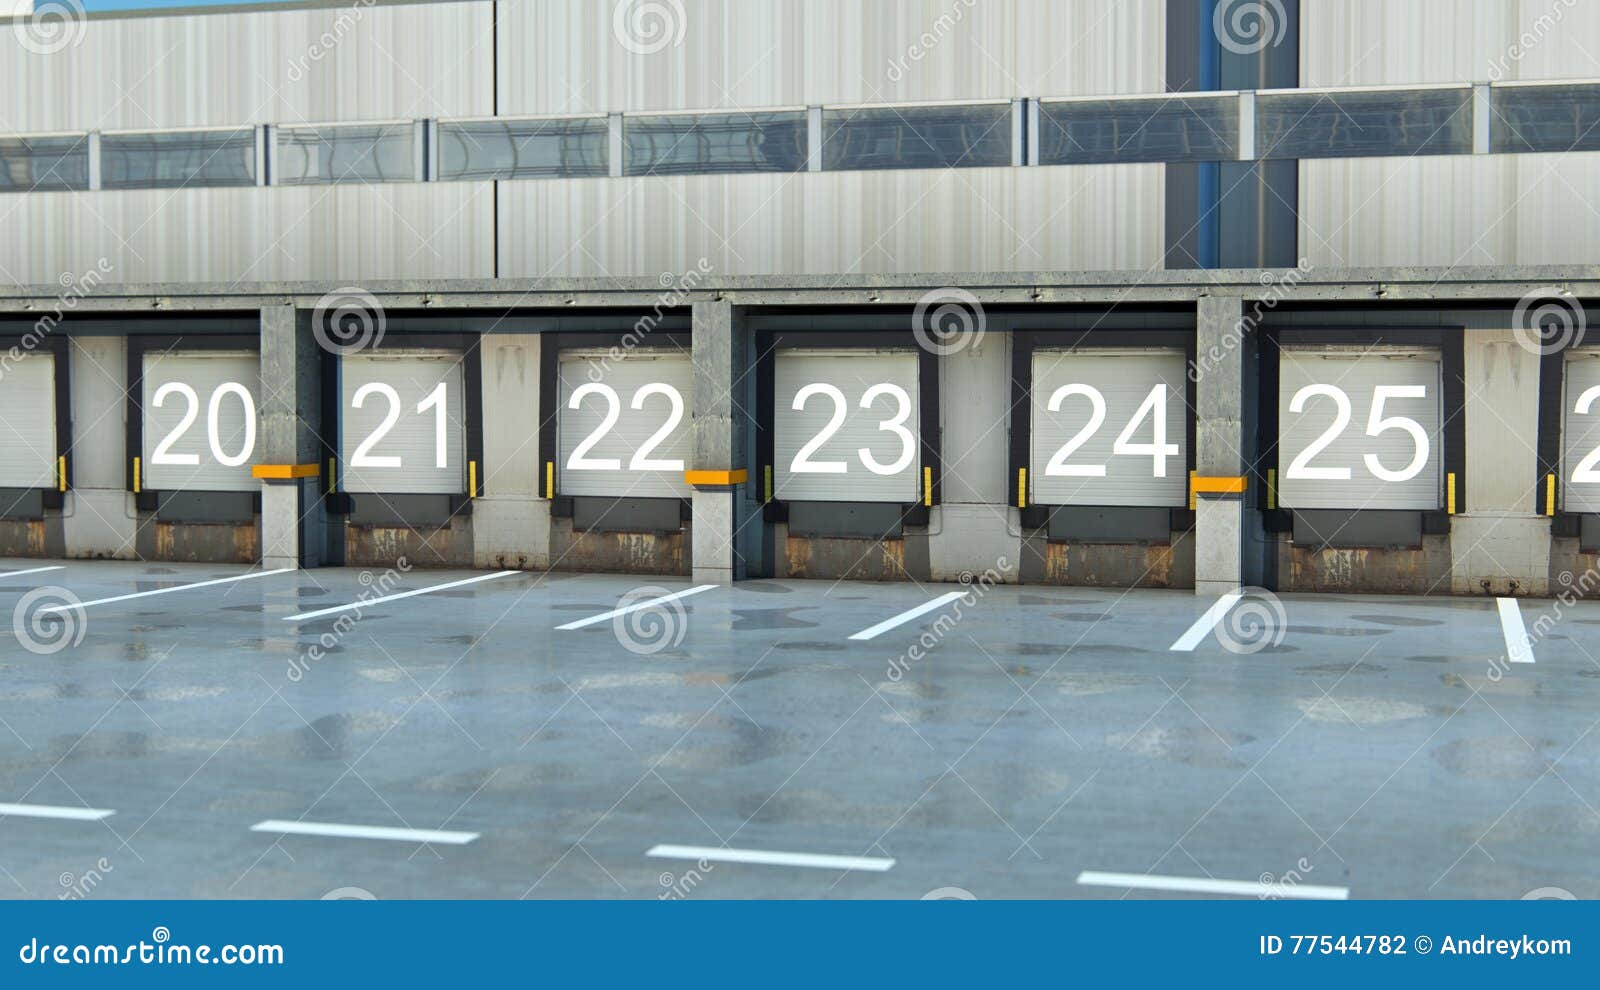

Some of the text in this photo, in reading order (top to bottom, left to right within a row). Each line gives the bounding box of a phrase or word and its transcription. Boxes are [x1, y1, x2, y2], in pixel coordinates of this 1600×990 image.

[151, 382, 256, 467] 20
[350, 382, 447, 468] 21
[566, 382, 685, 471] 22
[790, 383, 916, 475] 23
[1045, 383, 1179, 477] 24
[1286, 383, 1430, 482] 25
